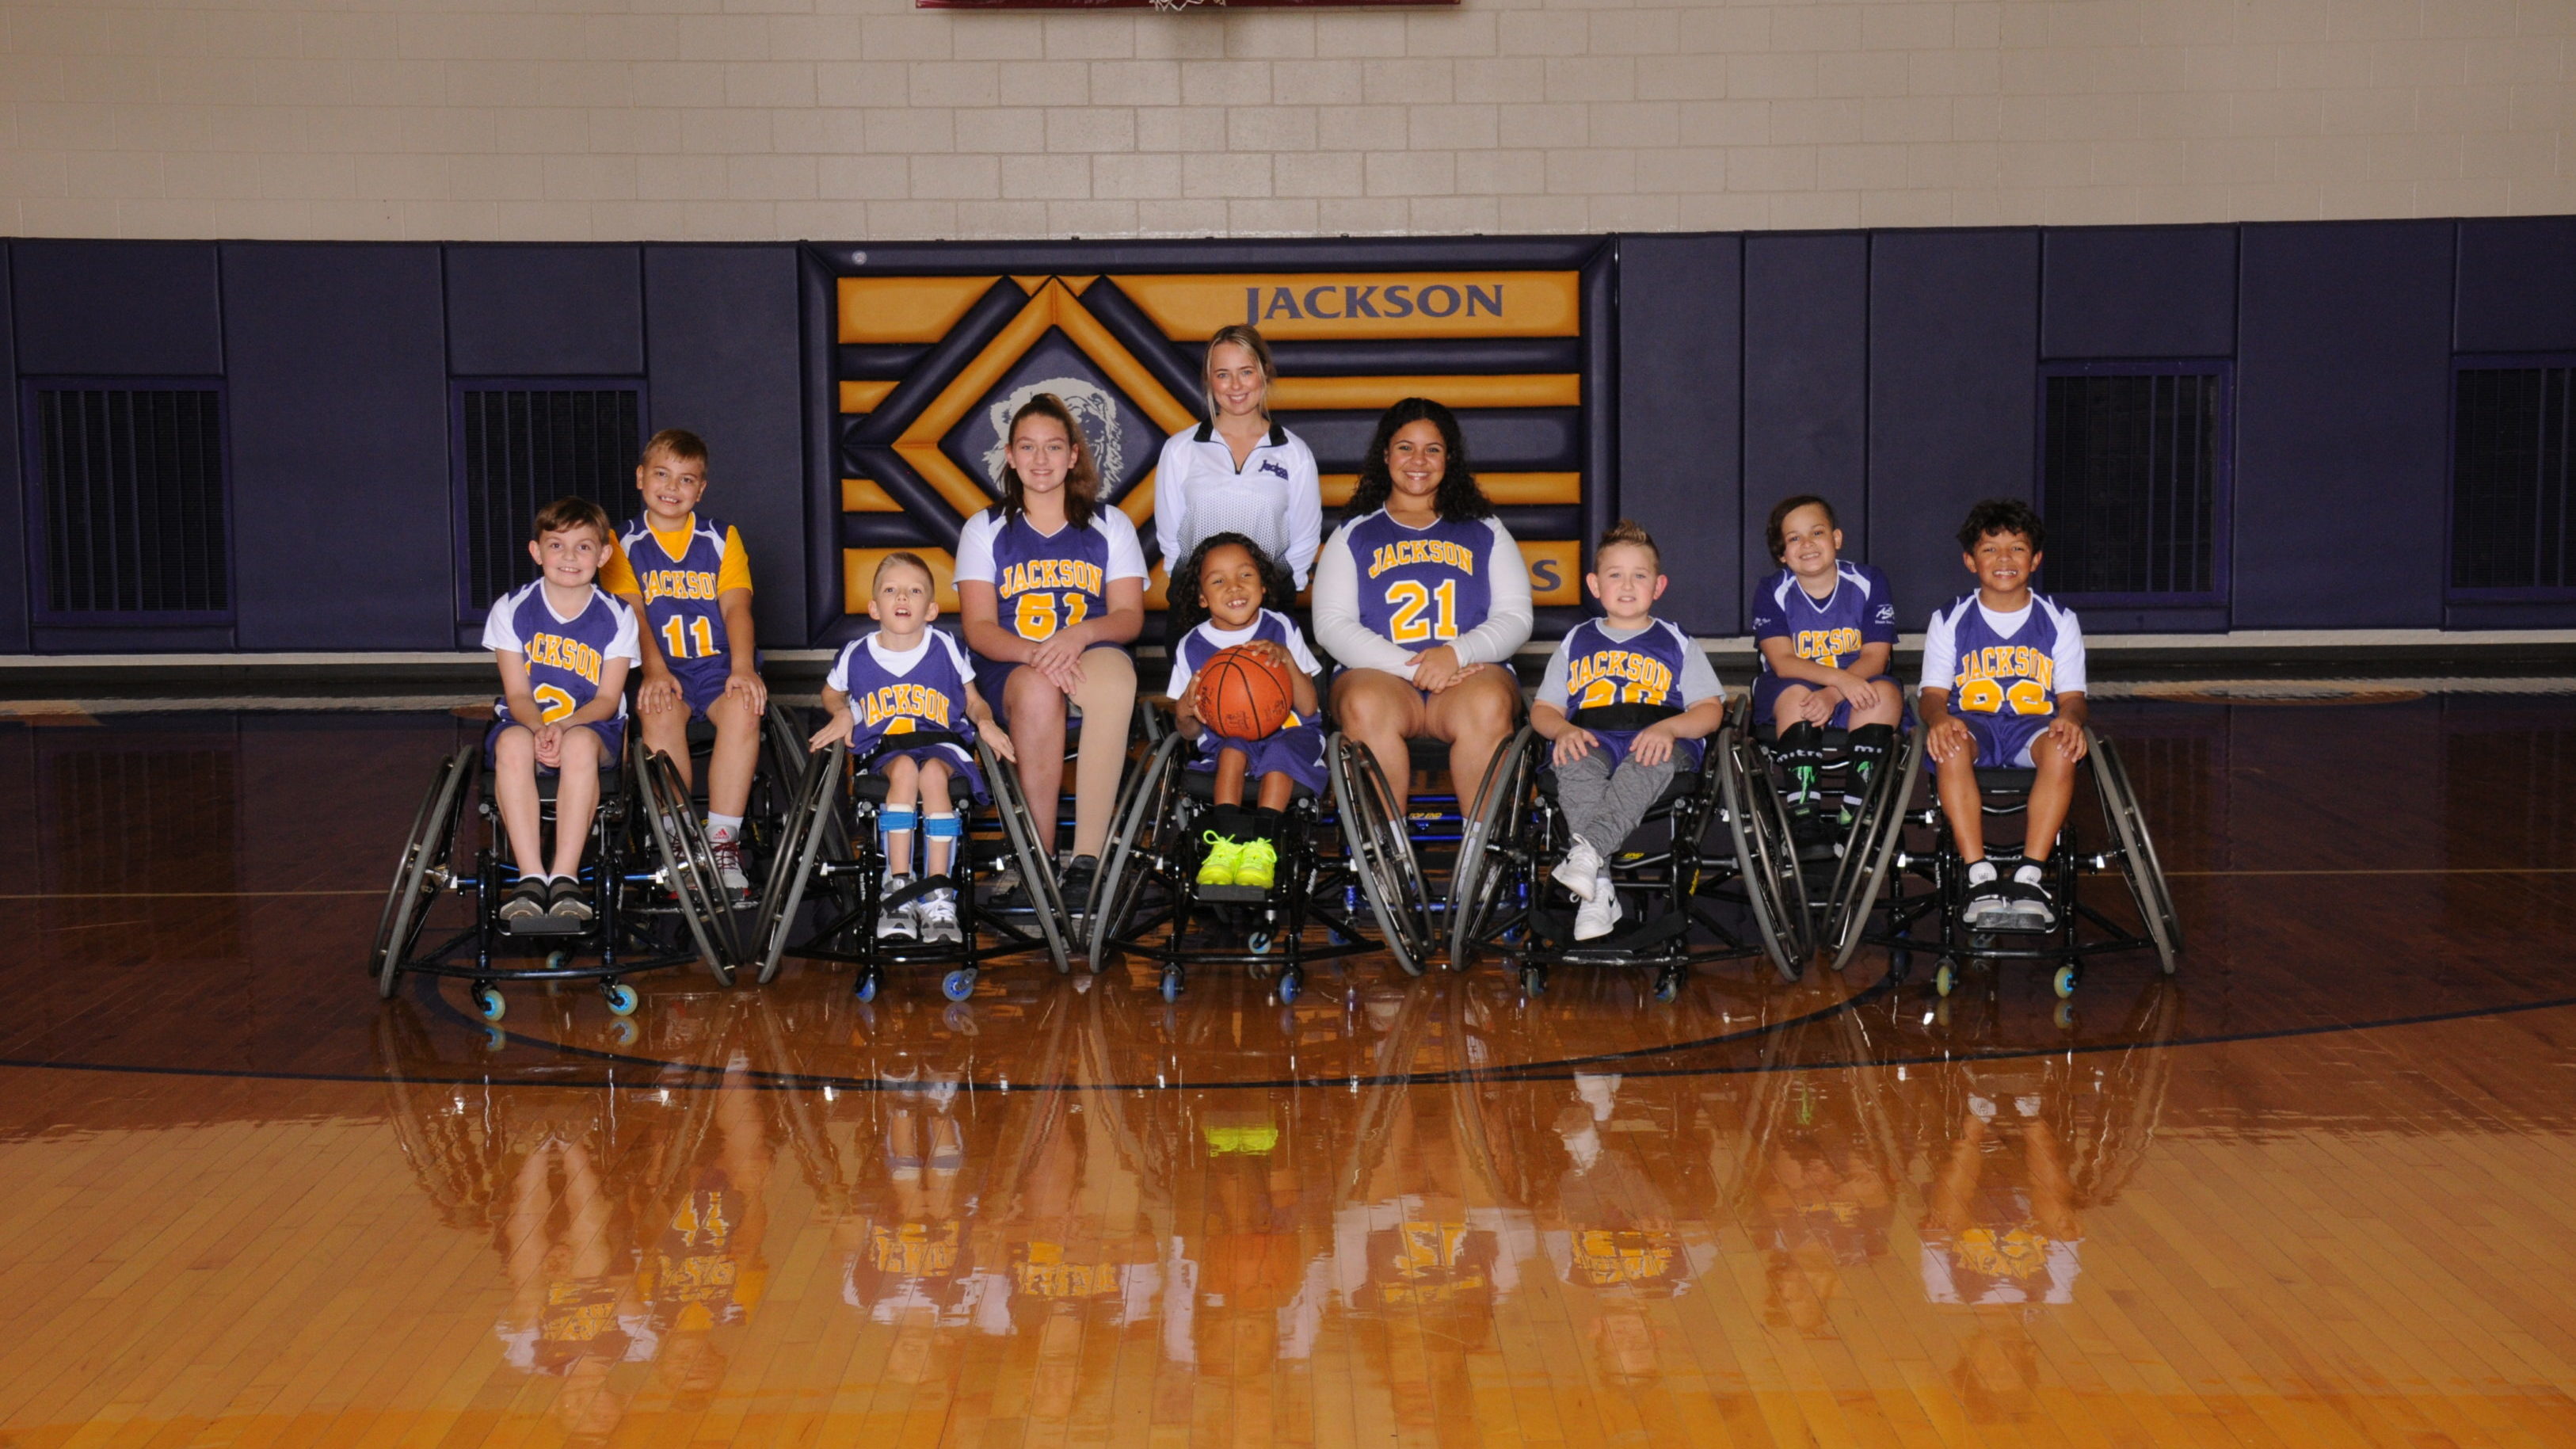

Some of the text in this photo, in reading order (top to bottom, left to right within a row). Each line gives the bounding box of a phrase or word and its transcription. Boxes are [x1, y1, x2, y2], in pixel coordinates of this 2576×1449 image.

[1245, 284, 1503, 327] JACKSON
[1000, 559, 1103, 600] JACKSON
[1369, 540, 1473, 578] JACKSON
[1385, 578, 1458, 644] 21
[661, 614, 722, 658] 11
[1567, 650, 1673, 696] JACKSON
[1955, 646, 2054, 691] JACKSON
